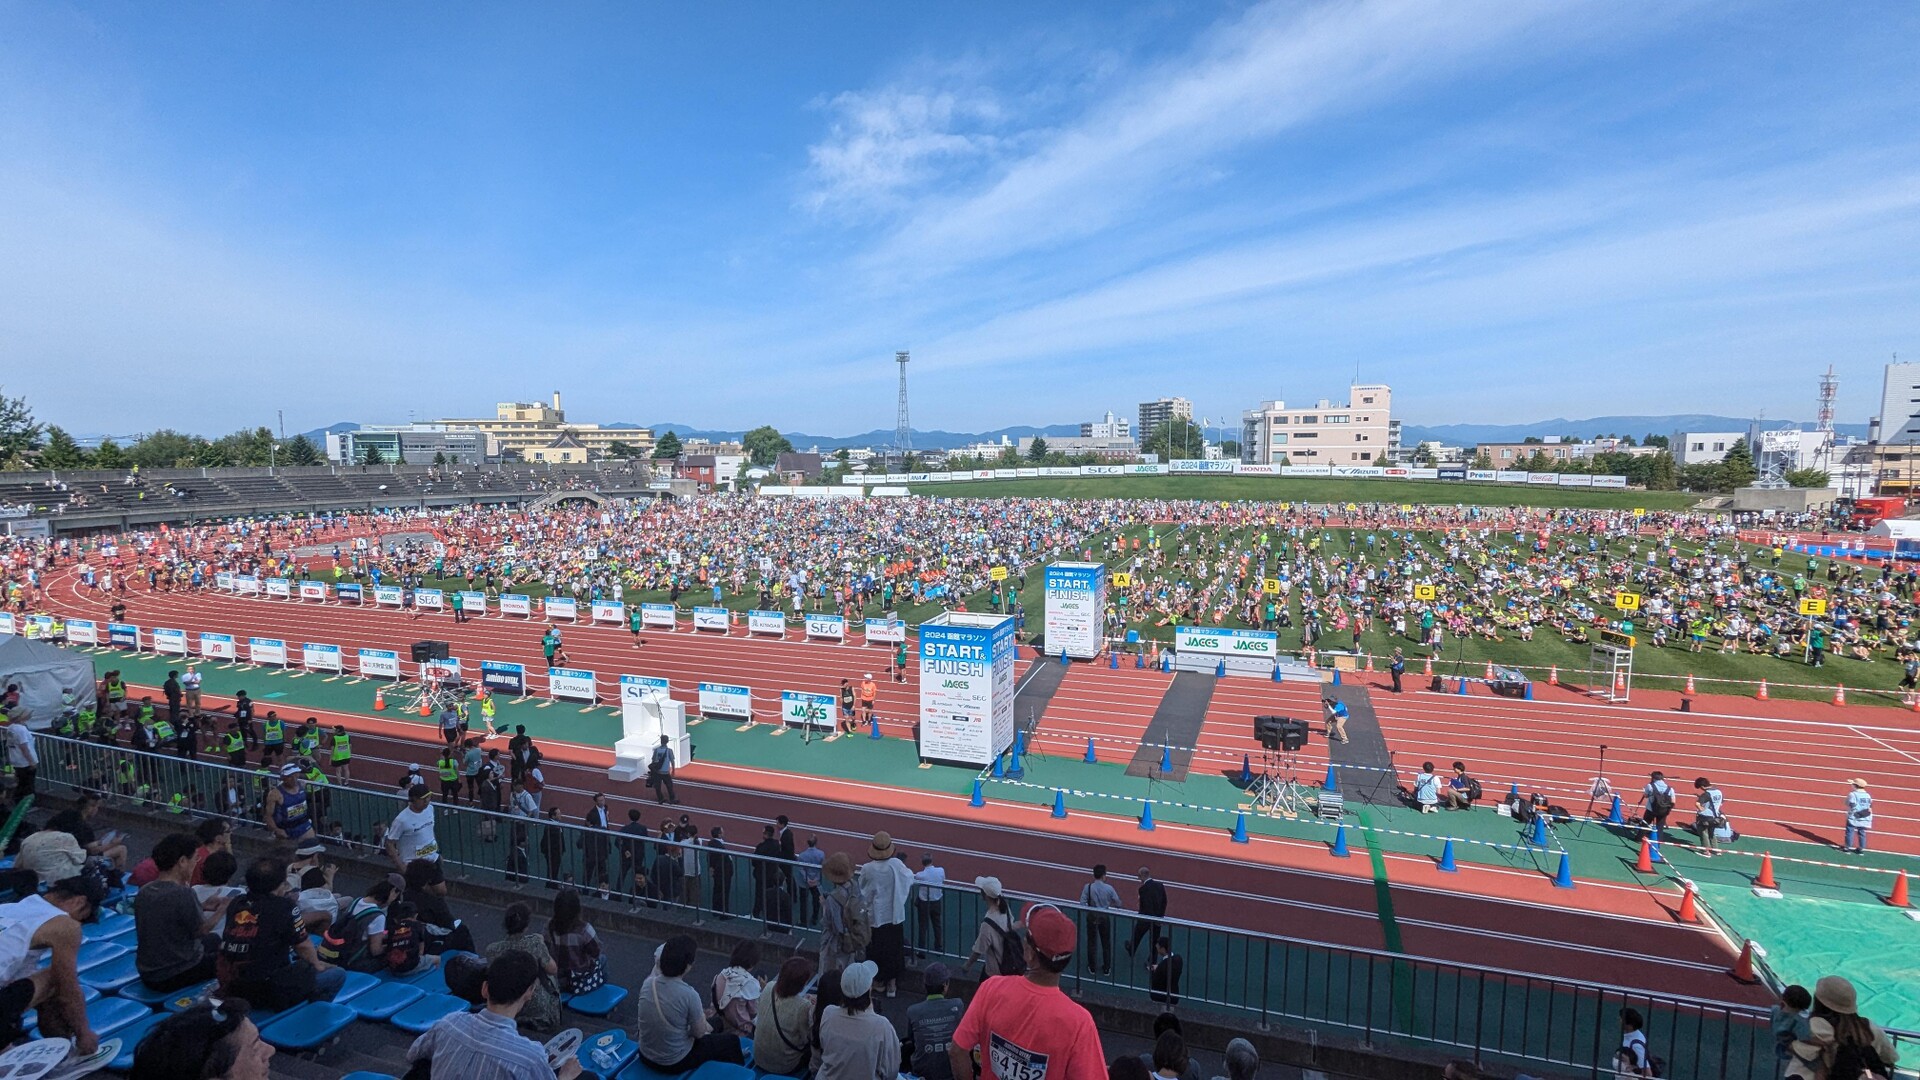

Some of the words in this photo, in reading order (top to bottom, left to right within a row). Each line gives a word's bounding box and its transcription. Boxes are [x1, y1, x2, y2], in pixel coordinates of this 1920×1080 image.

[1087, 466, 1118, 474] SEC
[1180, 461, 1198, 470] 2024
[1117, 575, 1126, 583] A
[1267, 581, 1276, 590] B
[1048, 589, 1090, 601] FINISH
[1420, 588, 1430, 596] C
[419, 596, 438, 605] SEC
[1622, 595, 1634, 605] D
[1807, 601, 1819, 611] E
[810, 622, 838, 634] SEC
[924, 631, 946, 639] 2024
[947, 632, 986, 642] 函館マラソン
[1184, 637, 1219, 648] JACCS
[1233, 640, 1268, 652] JACCS
[924, 658, 984, 677] FINISH
[563, 685, 590, 693] KITAGAS
[941, 679, 969, 690] JACCS
[1000, 1055, 1043, 1080] 4152
